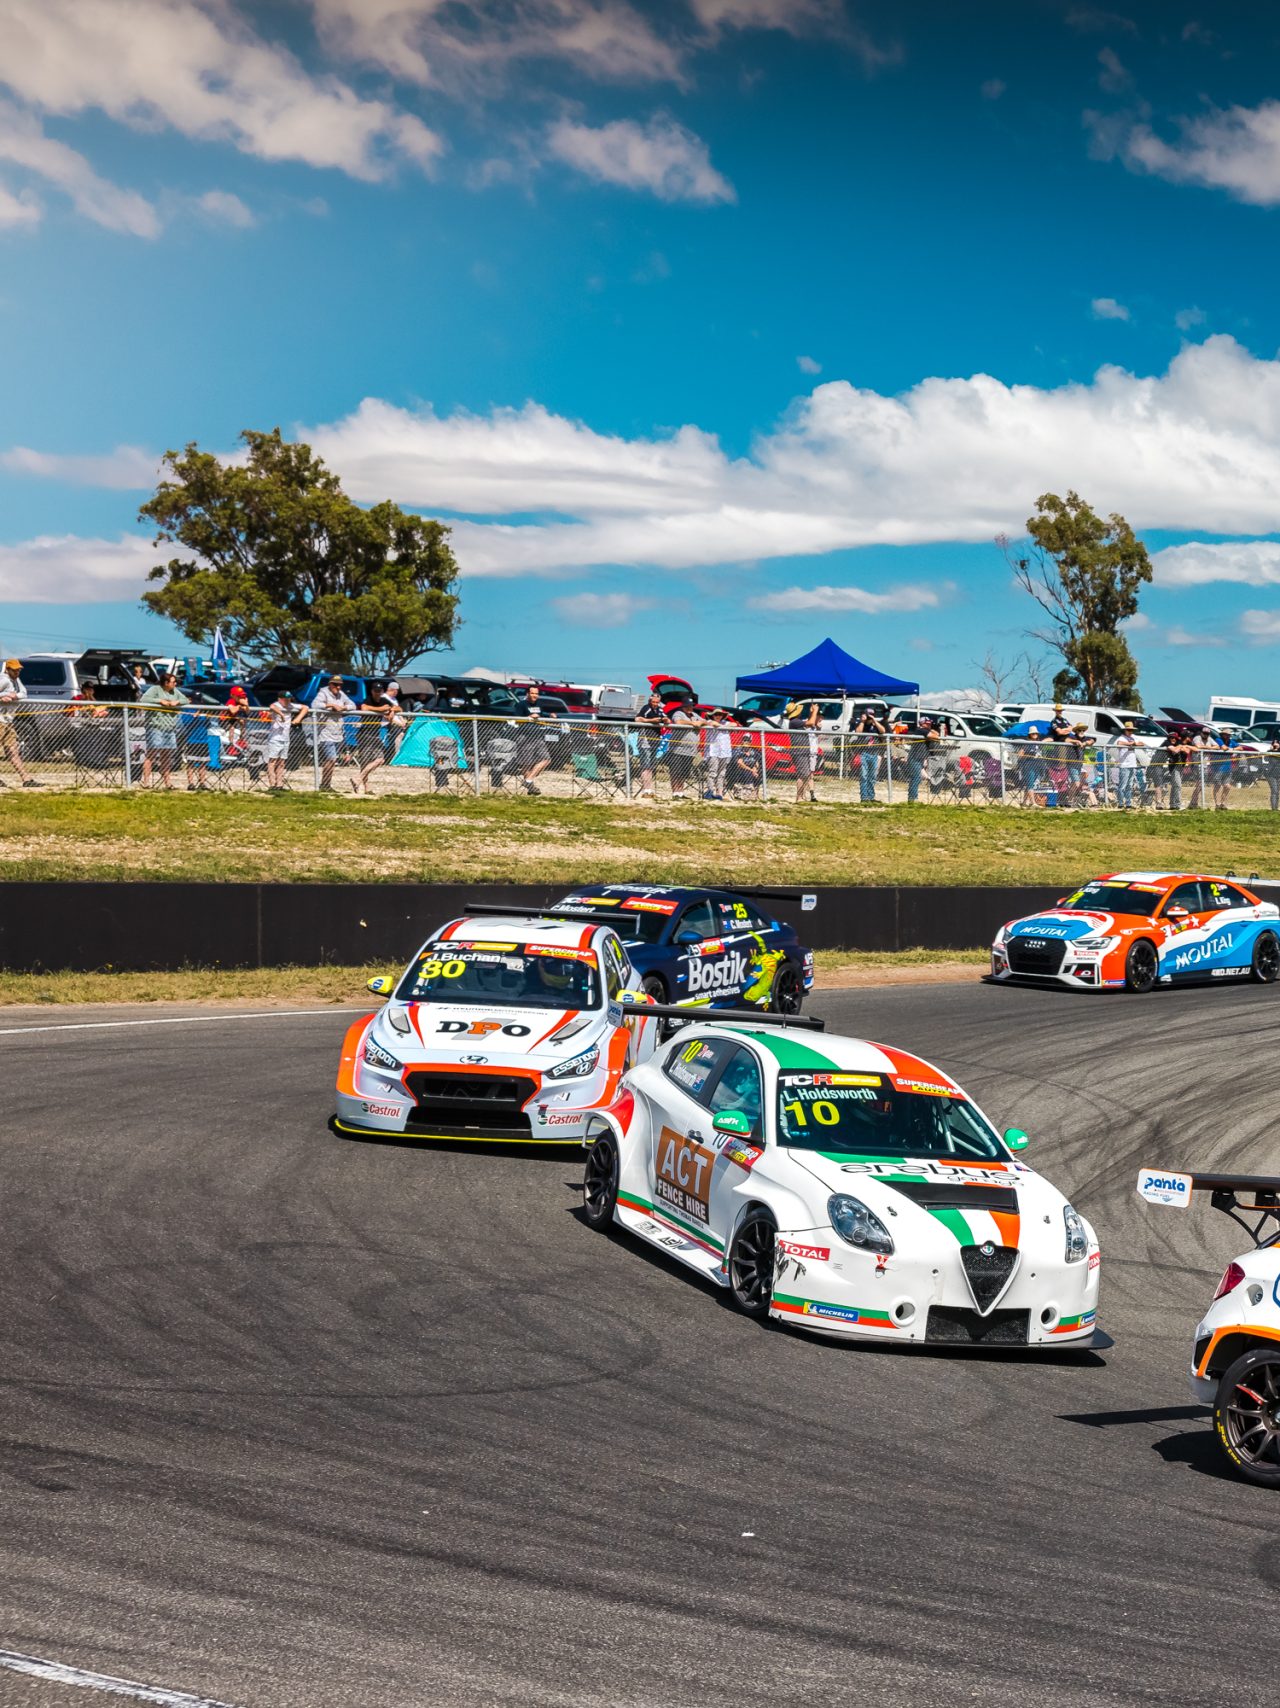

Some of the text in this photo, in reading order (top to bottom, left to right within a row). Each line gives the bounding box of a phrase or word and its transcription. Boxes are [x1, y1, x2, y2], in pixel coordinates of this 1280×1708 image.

[1210, 883, 1221, 896] 2
[732, 902, 748, 919] 25
[1020, 926, 1068, 937] MOUTAI
[432, 942, 476, 951] TCR
[529, 944, 593, 957] SUPERCHEAP
[1175, 932, 1234, 970] MOUTAI
[418, 960, 467, 979] 30
[688, 950, 748, 992] Bostik
[694, 985, 741, 1000] smart adhesives
[435, 1020, 531, 1037] DPO
[681, 1040, 703, 1062] 10
[778, 1073, 834, 1086] TCR
[896, 1077, 960, 1094] SUPERCHEAP
[916, 1086, 948, 1094] AUTO
[369, 1104, 401, 1118] Castrol
[548, 1114, 583, 1125] Castrol
[784, 1100, 840, 1126] 10
[661, 1138, 708, 1195] ACT
[840, 1162, 1021, 1181] erebus
[1143, 1176, 1186, 1192] panta
[657, 1178, 707, 1221] FENCE HIRE
[782, 1241, 827, 1259] TOTAL
[818, 1308, 855, 1319] MICHELIN
